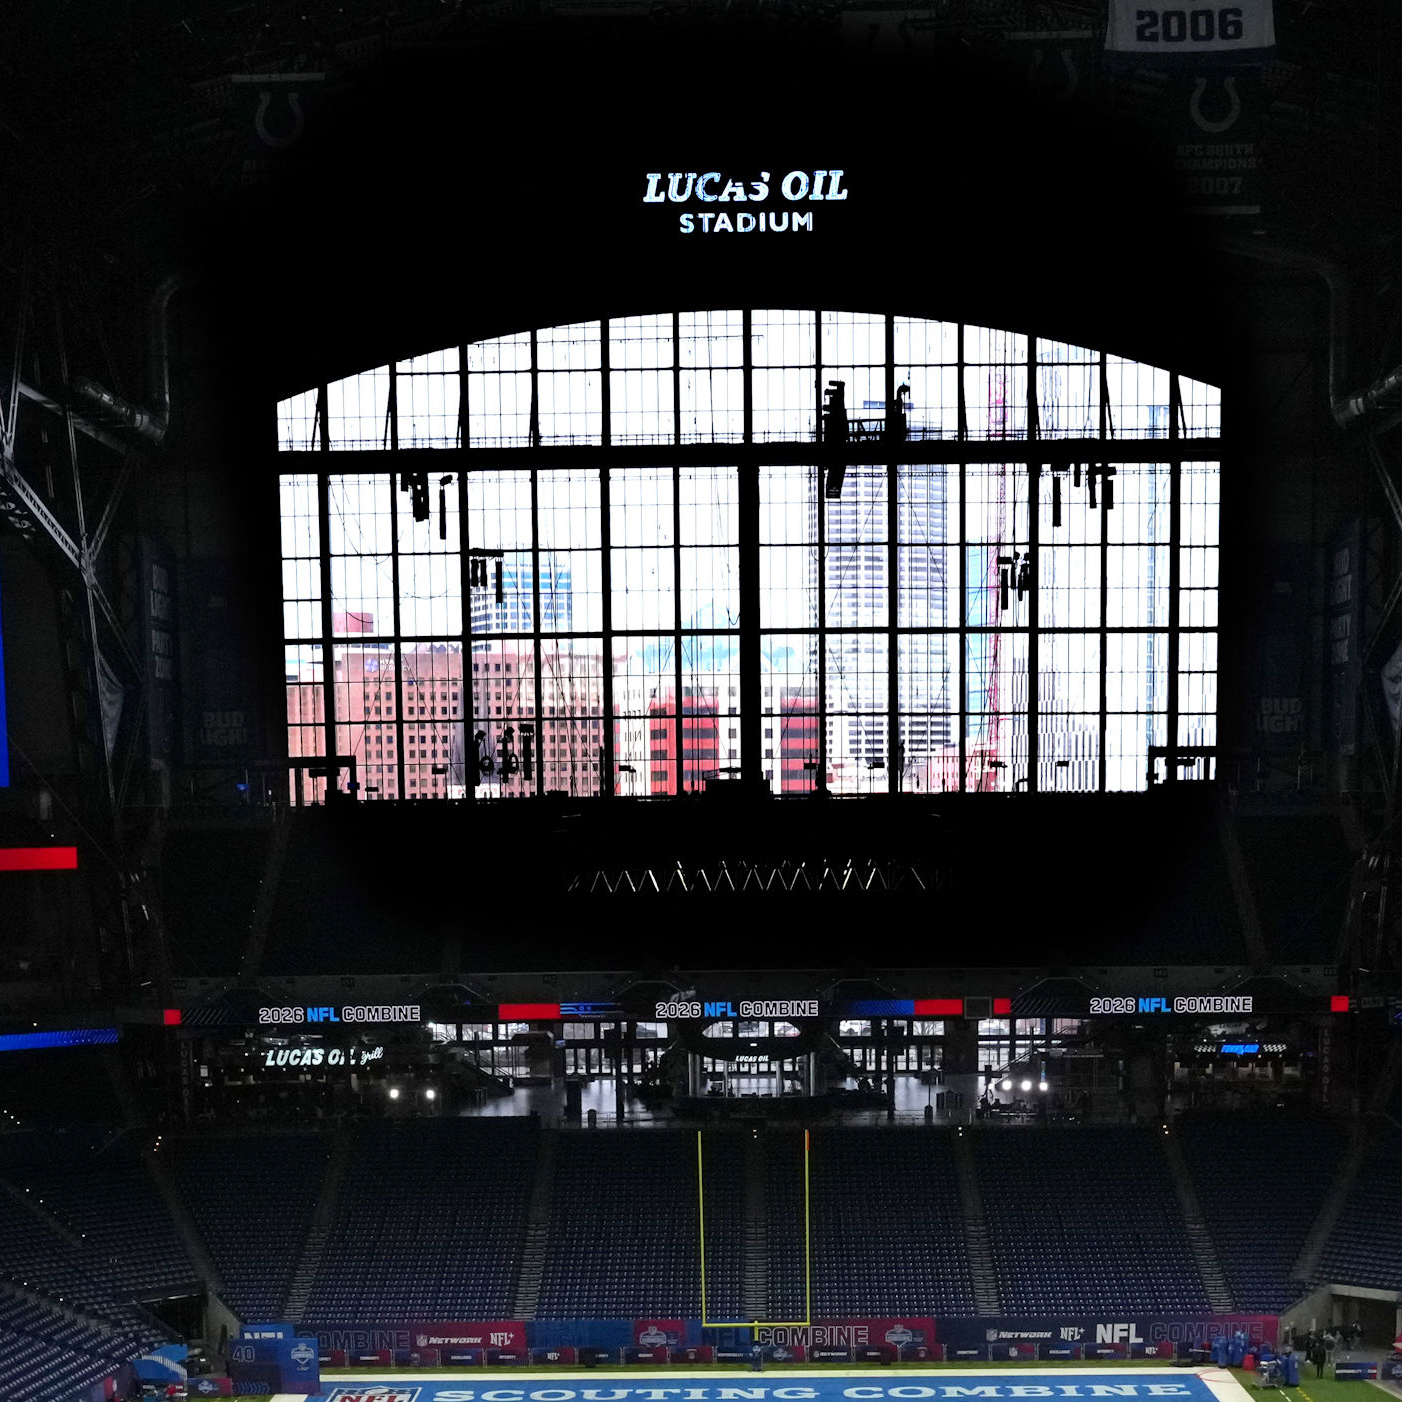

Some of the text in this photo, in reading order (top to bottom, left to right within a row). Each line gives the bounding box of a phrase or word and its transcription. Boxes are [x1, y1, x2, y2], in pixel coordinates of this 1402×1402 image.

[1136, 8, 1243, 43] 2006
[643, 170, 848, 202] LUCAS OIL
[679, 212, 813, 234] STADIUM
[656, 1000, 819, 1018] 2026 NFL COMBINE
[1090, 996, 1253, 1014] 2026 NFL COMBINE
[259, 1005, 421, 1024] 2026 NFL COMBINE
[265, 1046, 385, 1067] LUCAS grill
[734, 1055, 758, 1063] LUCAS
[428, 1336, 483, 1345] NETWORK
[759, 1325, 869, 1348] COMBINE
[998, 1330, 1053, 1339] NETWORK
[1096, 1323, 1144, 1343] NFL
[232, 1345, 256, 1363] 40
[434, 1384, 1192, 1402] SCOUTING COMBINE
